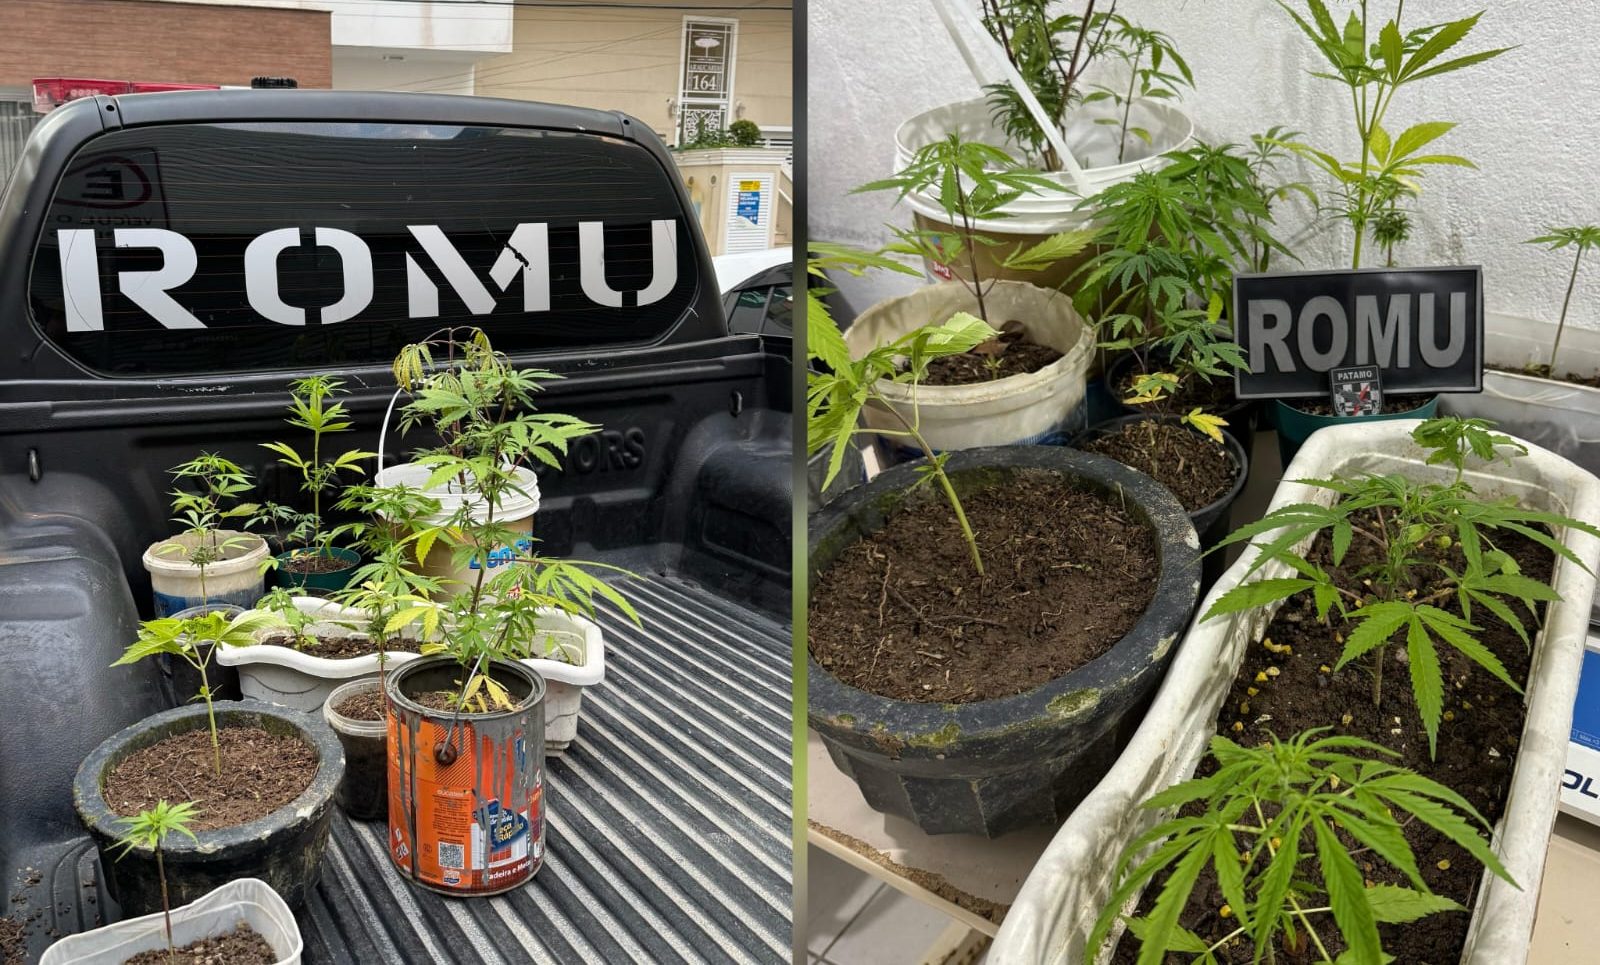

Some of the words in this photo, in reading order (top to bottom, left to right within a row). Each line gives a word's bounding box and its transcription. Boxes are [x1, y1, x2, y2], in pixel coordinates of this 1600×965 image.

[692, 74, 717, 91] 164
[57, 219, 678, 333] ROMU
[1247, 291, 1467, 374] ROMU
[1337, 370, 1373, 381] PATAMO
